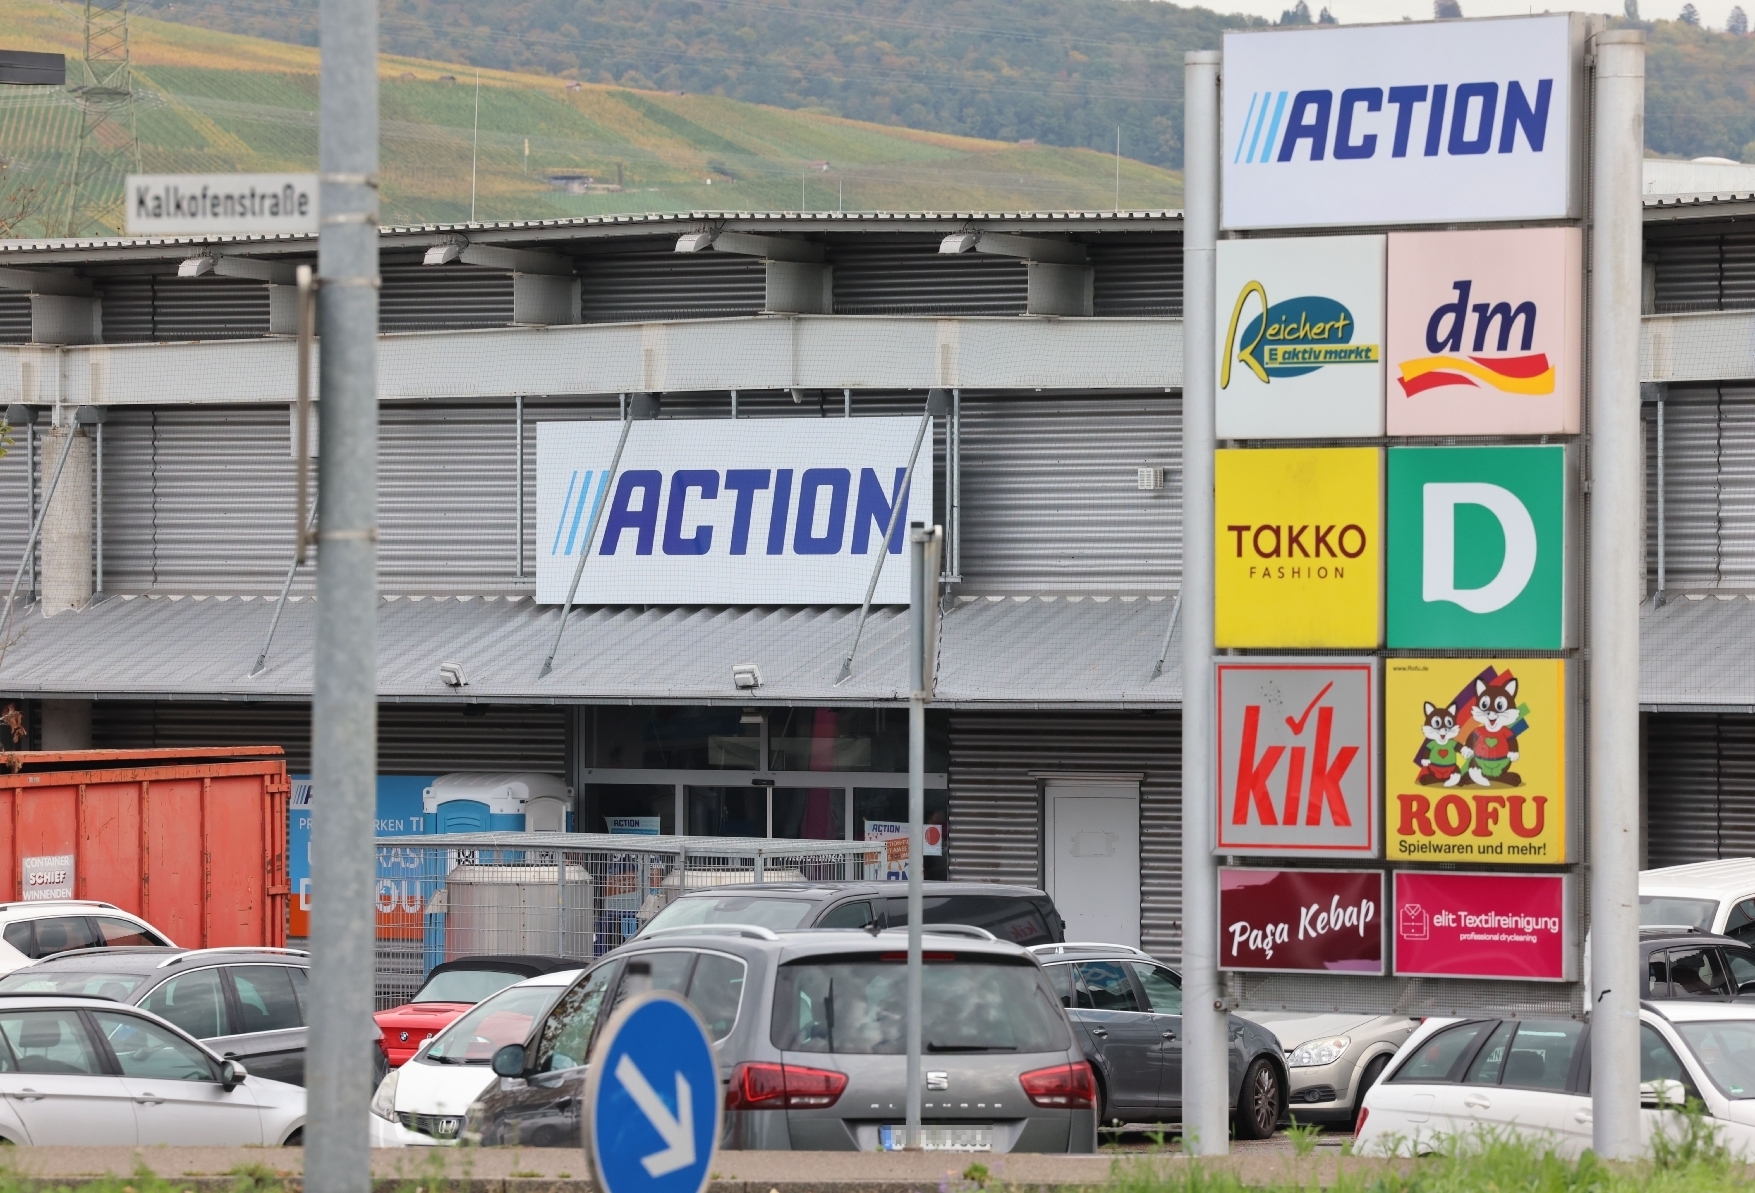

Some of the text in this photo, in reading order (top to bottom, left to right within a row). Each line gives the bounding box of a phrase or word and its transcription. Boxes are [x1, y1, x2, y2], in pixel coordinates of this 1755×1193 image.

[1277, 79, 1553, 162] ACTION
[136, 183, 310, 218] Kalkofenstraße
[1425, 280, 1537, 354] dm
[1220, 280, 1351, 389] Reichert
[1282, 348, 1322, 361] aktiv
[1323, 346, 1372, 360] markt
[599, 467, 912, 556] ACTION
[1422, 482, 1537, 614] D
[1249, 566, 1345, 579] FASHION
[613, 819, 640, 828] ACTION
[1396, 794, 1548, 838] ROFU
[872, 823, 900, 834] ACTION
[1398, 839, 1547, 856] Spielwaren und mehr!
[25, 856, 70, 868] CONTAINER
[29, 870, 66, 885] SCHIEF
[23, 888, 72, 901] WINNENDEN
[1228, 894, 1375, 960] Paşa Kebap
[1433, 909, 1559, 933] elit Textilreinigung
[1459, 932, 1537, 943] professional drycleaning
